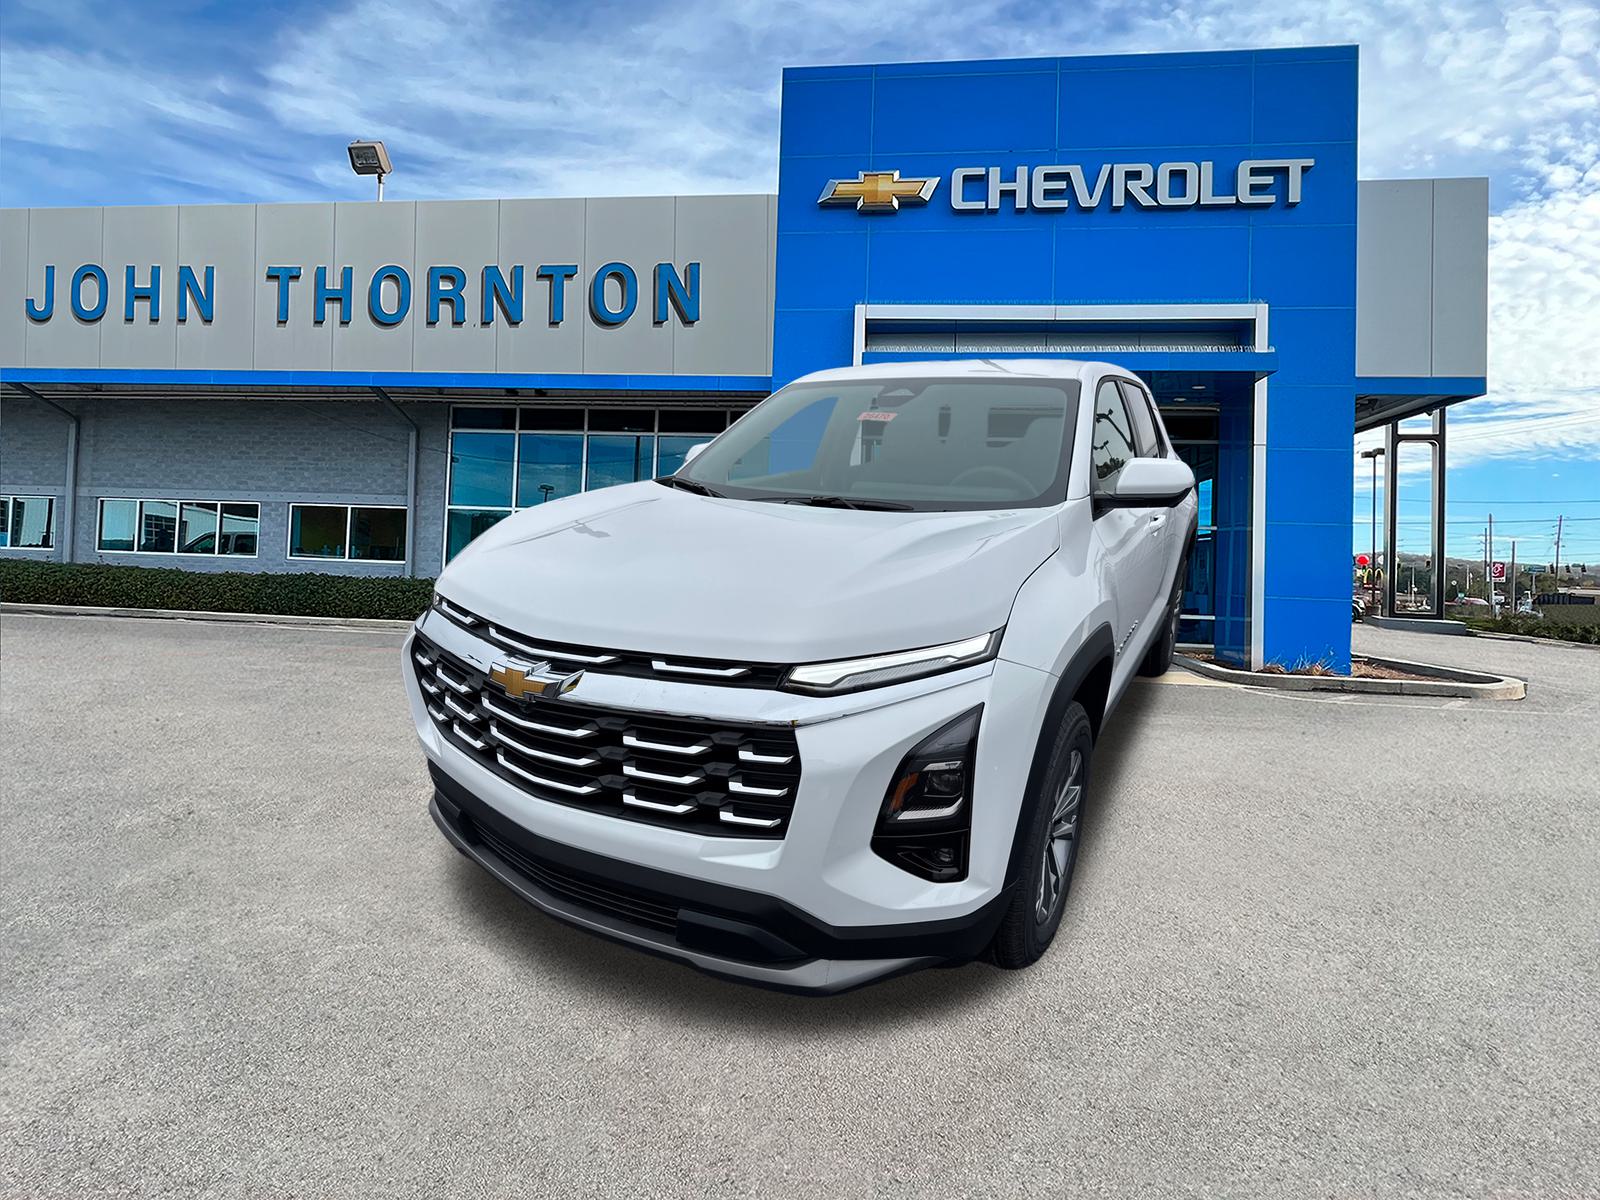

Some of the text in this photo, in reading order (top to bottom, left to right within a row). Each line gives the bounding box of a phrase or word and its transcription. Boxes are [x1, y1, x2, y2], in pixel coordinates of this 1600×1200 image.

[951, 158, 1315, 213] CHEVROLET
[26, 262, 702, 328] JOHN THORNTON
